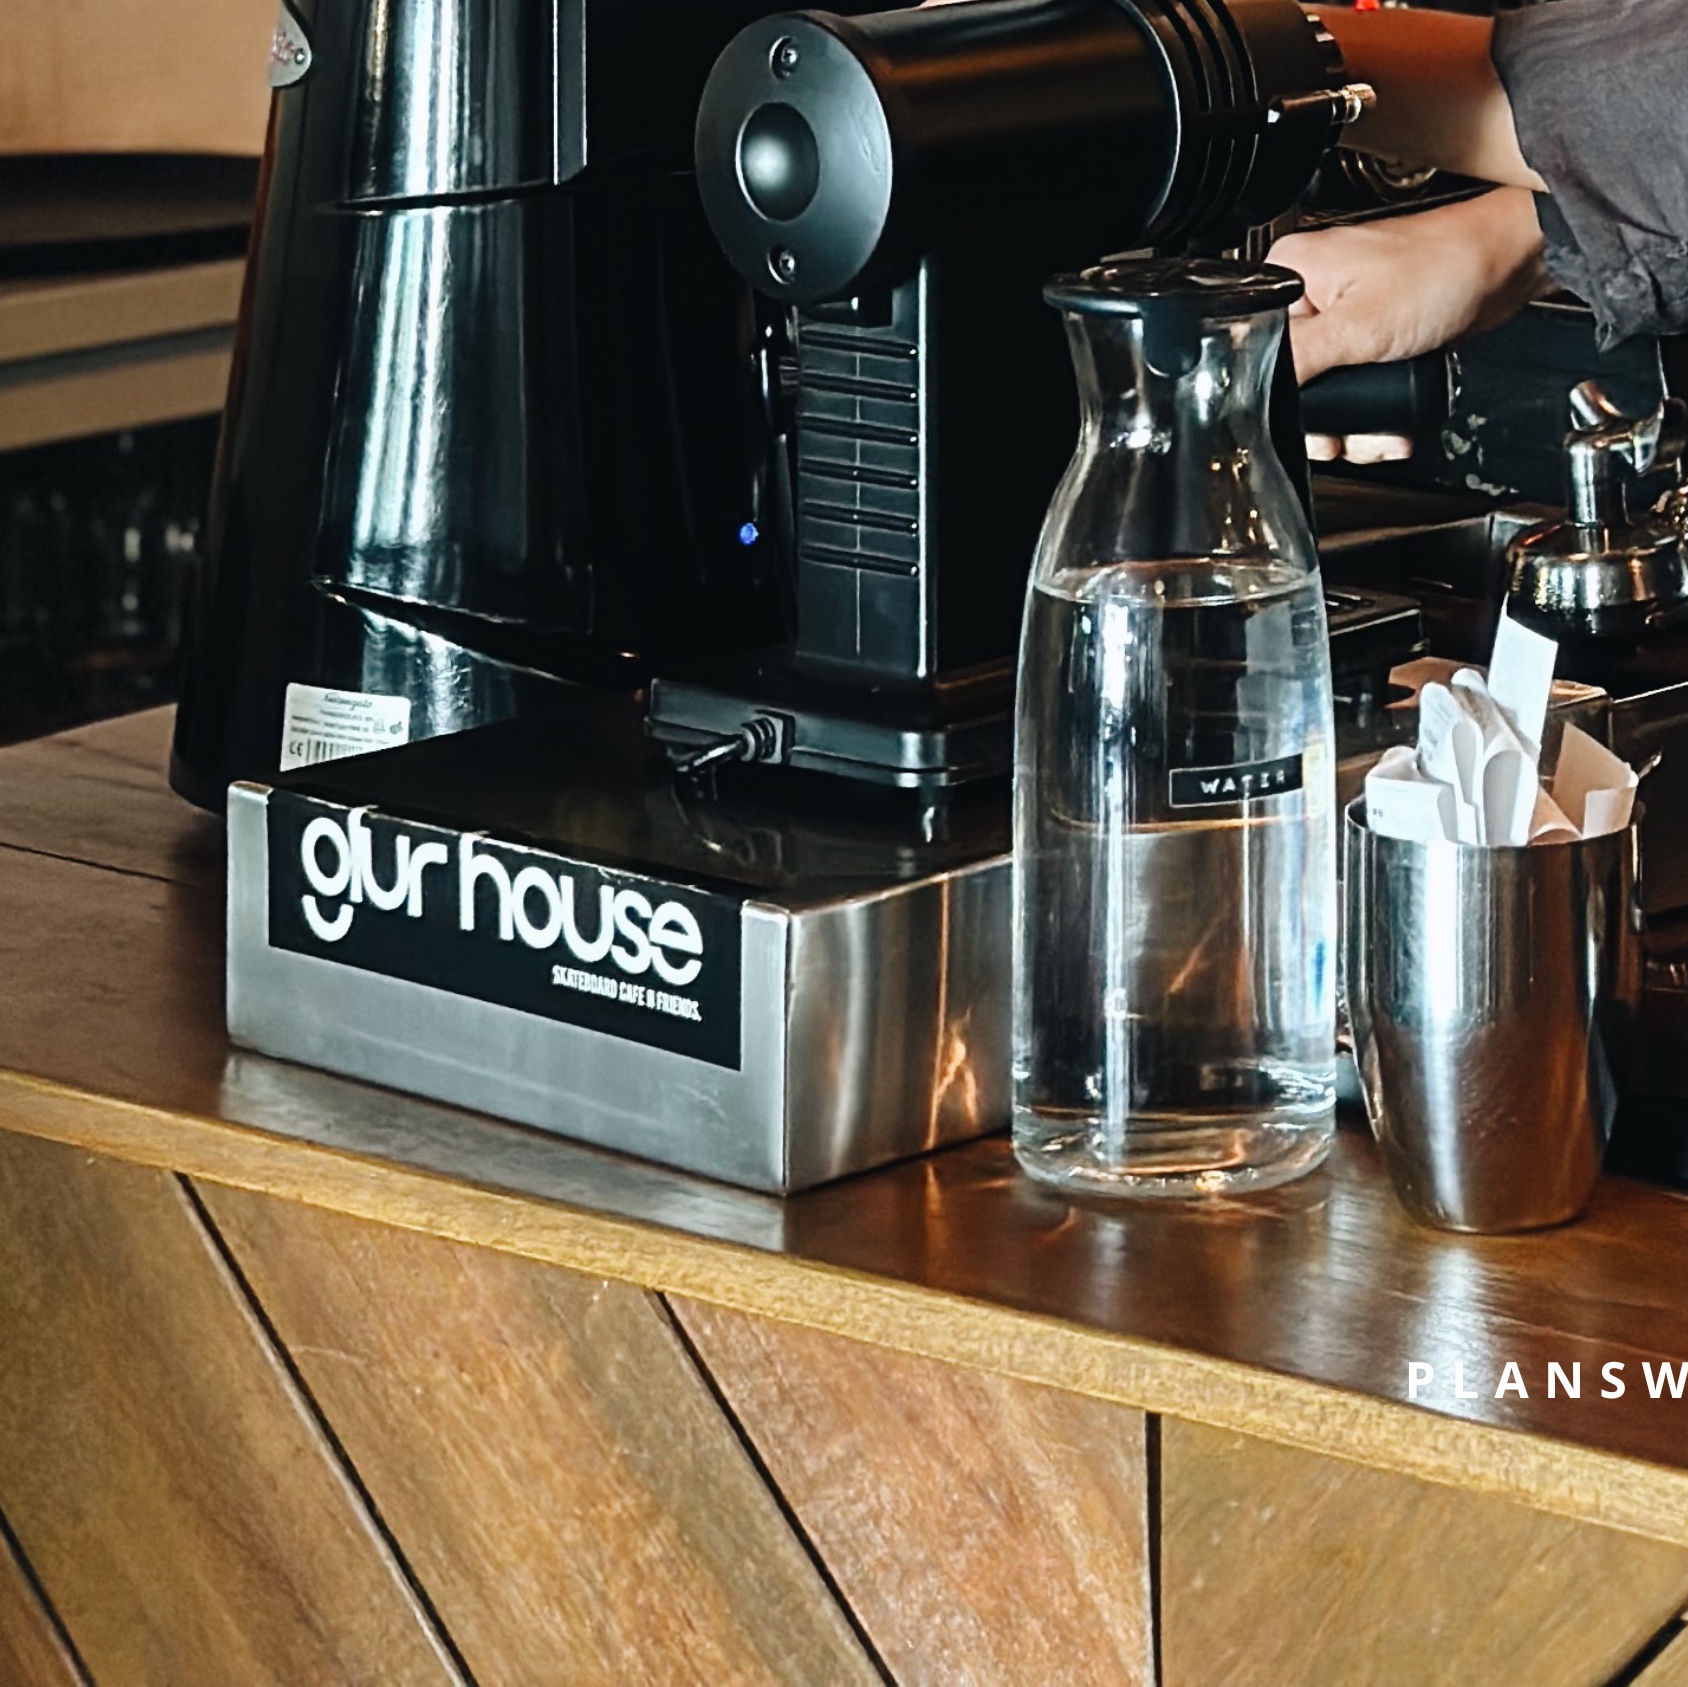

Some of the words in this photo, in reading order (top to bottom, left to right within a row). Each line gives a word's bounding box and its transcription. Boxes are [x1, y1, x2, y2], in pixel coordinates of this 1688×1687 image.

[458, 832, 703, 986] house
[552, 965, 618, 1000] SKATEBOARD
[618, 981, 646, 1007] CAFE
